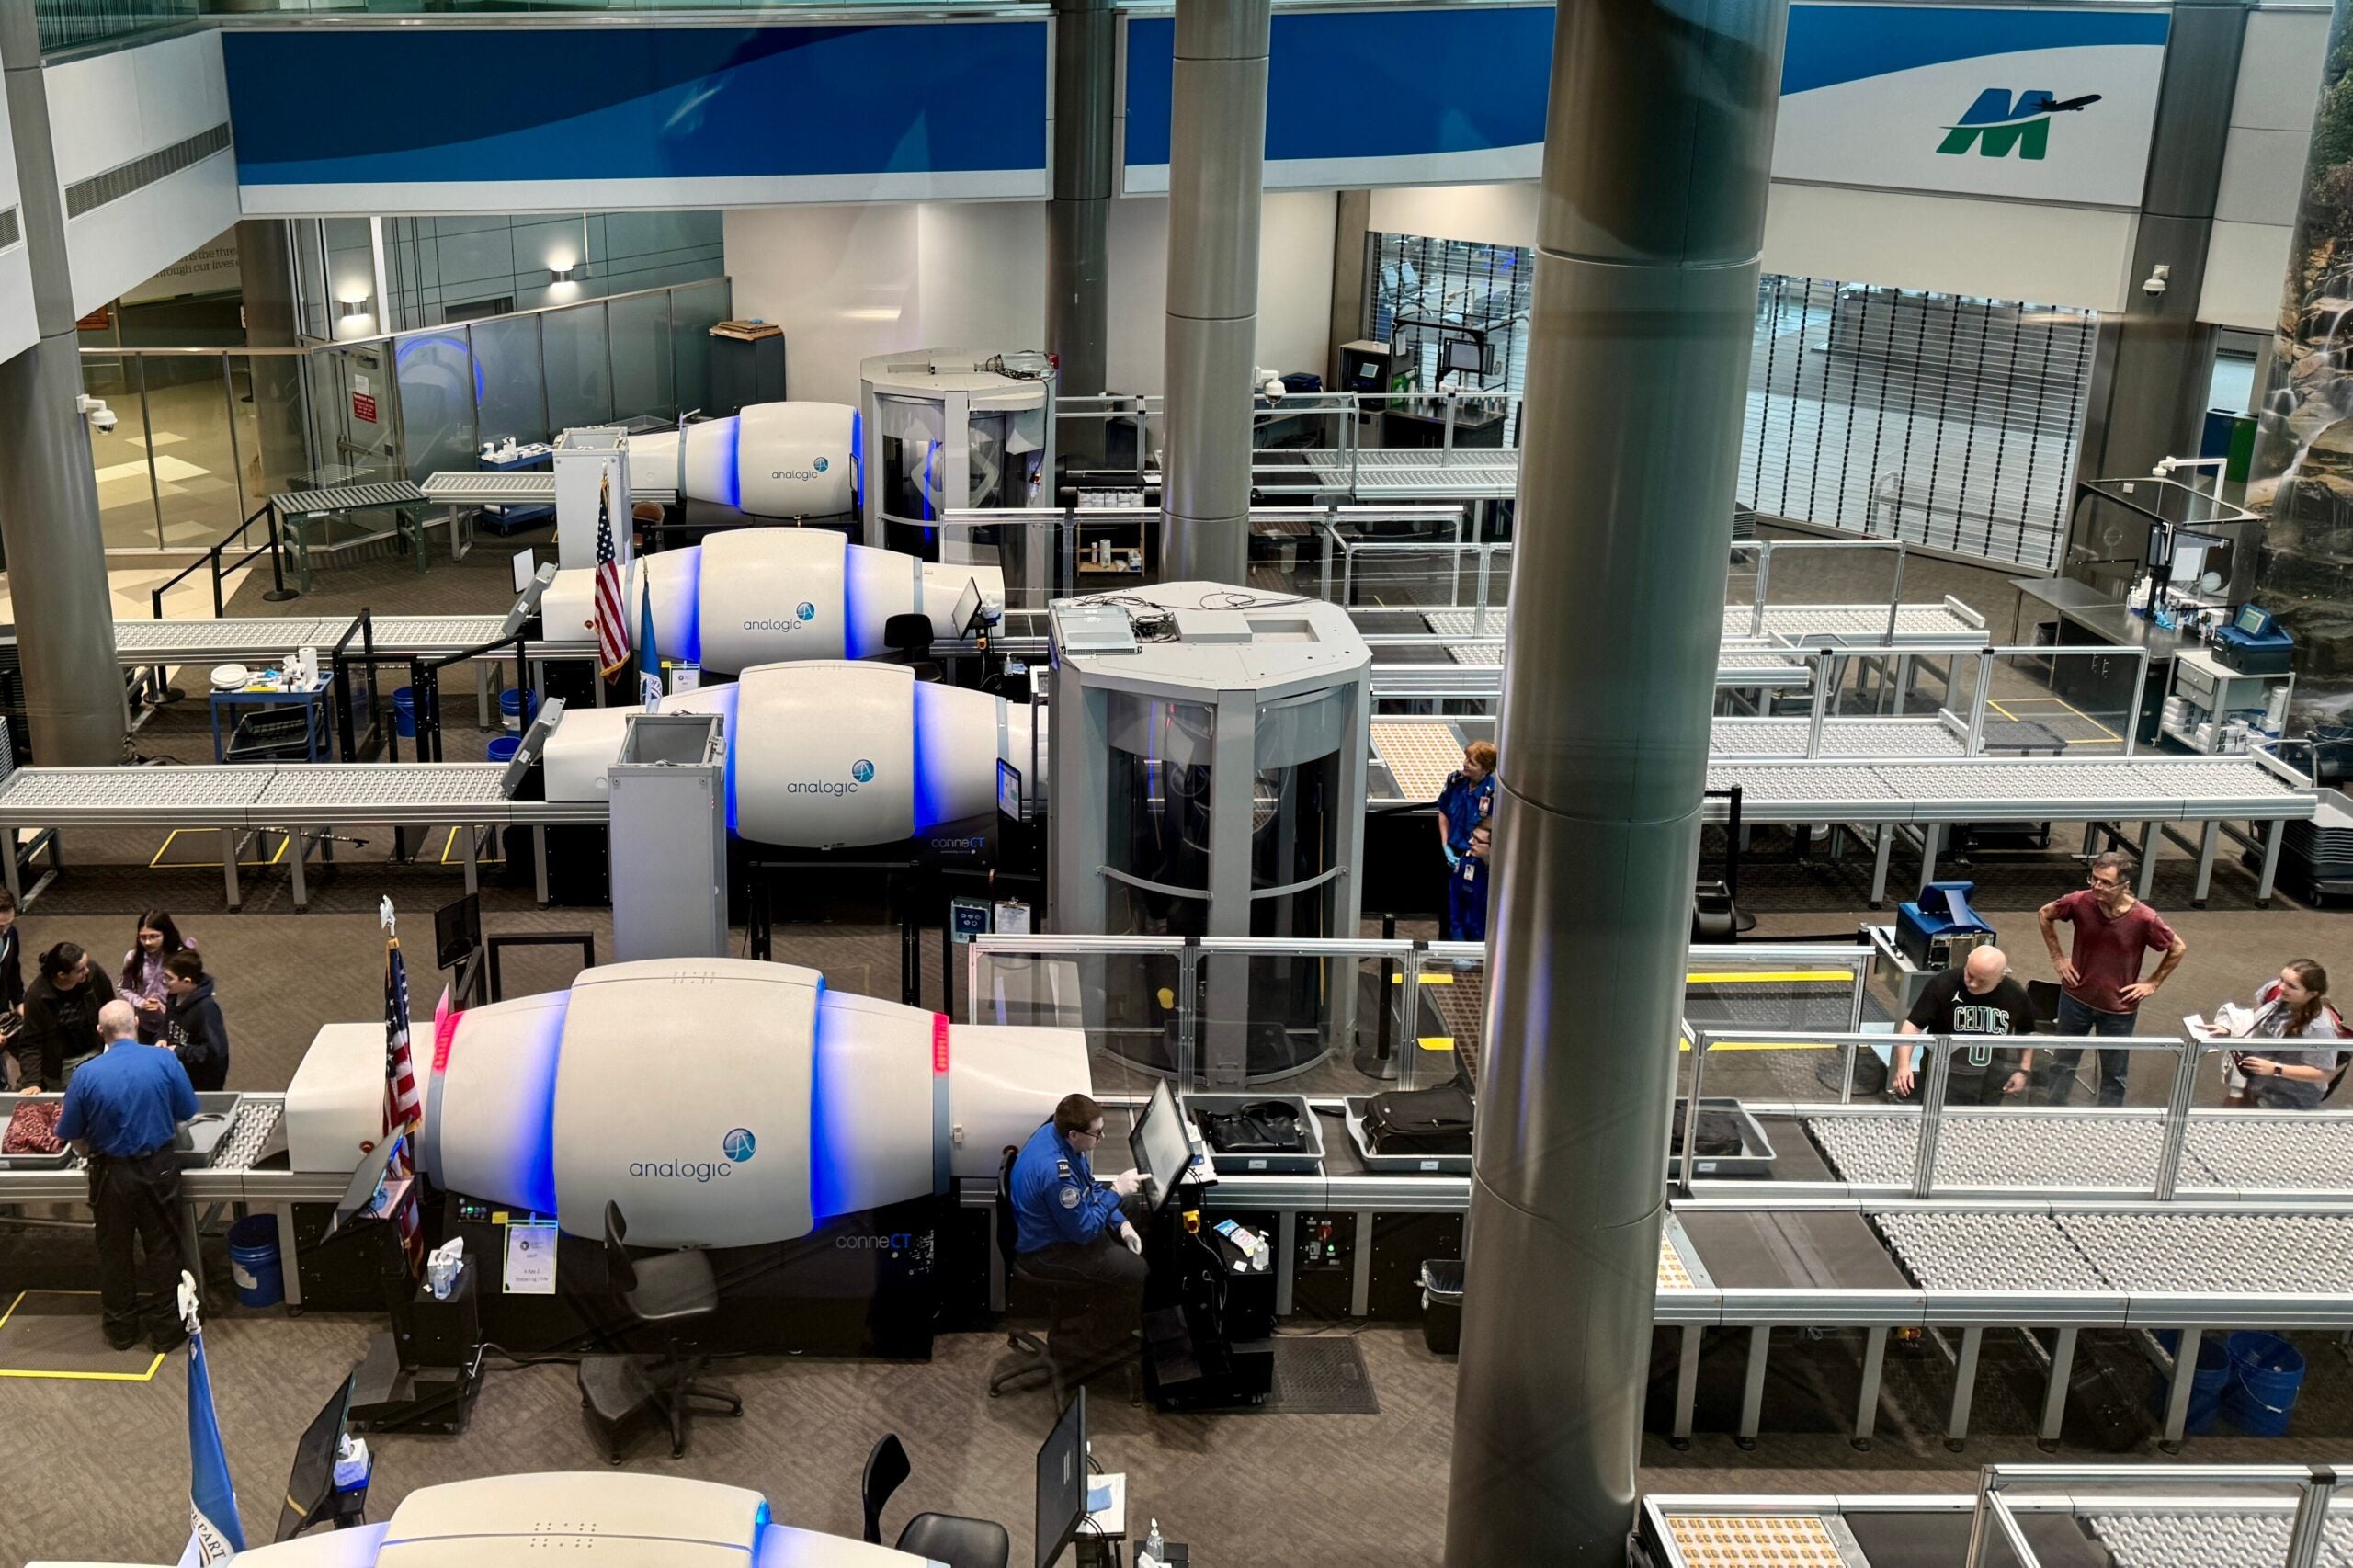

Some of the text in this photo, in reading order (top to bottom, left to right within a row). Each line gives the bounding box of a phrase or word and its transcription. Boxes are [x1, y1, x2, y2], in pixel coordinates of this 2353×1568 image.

[198, 249, 215, 259] the
[193, 263, 210, 272] our
[212, 259, 234, 270] lives
[771, 470, 818, 481] analogic
[743, 619, 801, 632] analogic
[787, 779, 858, 797] analogic
[931, 837, 985, 848] conneCT
[1953, 1006, 2010, 1036] CELTICS
[629, 1158, 732, 1183] analogic
[835, 1233, 913, 1249] conneCT
